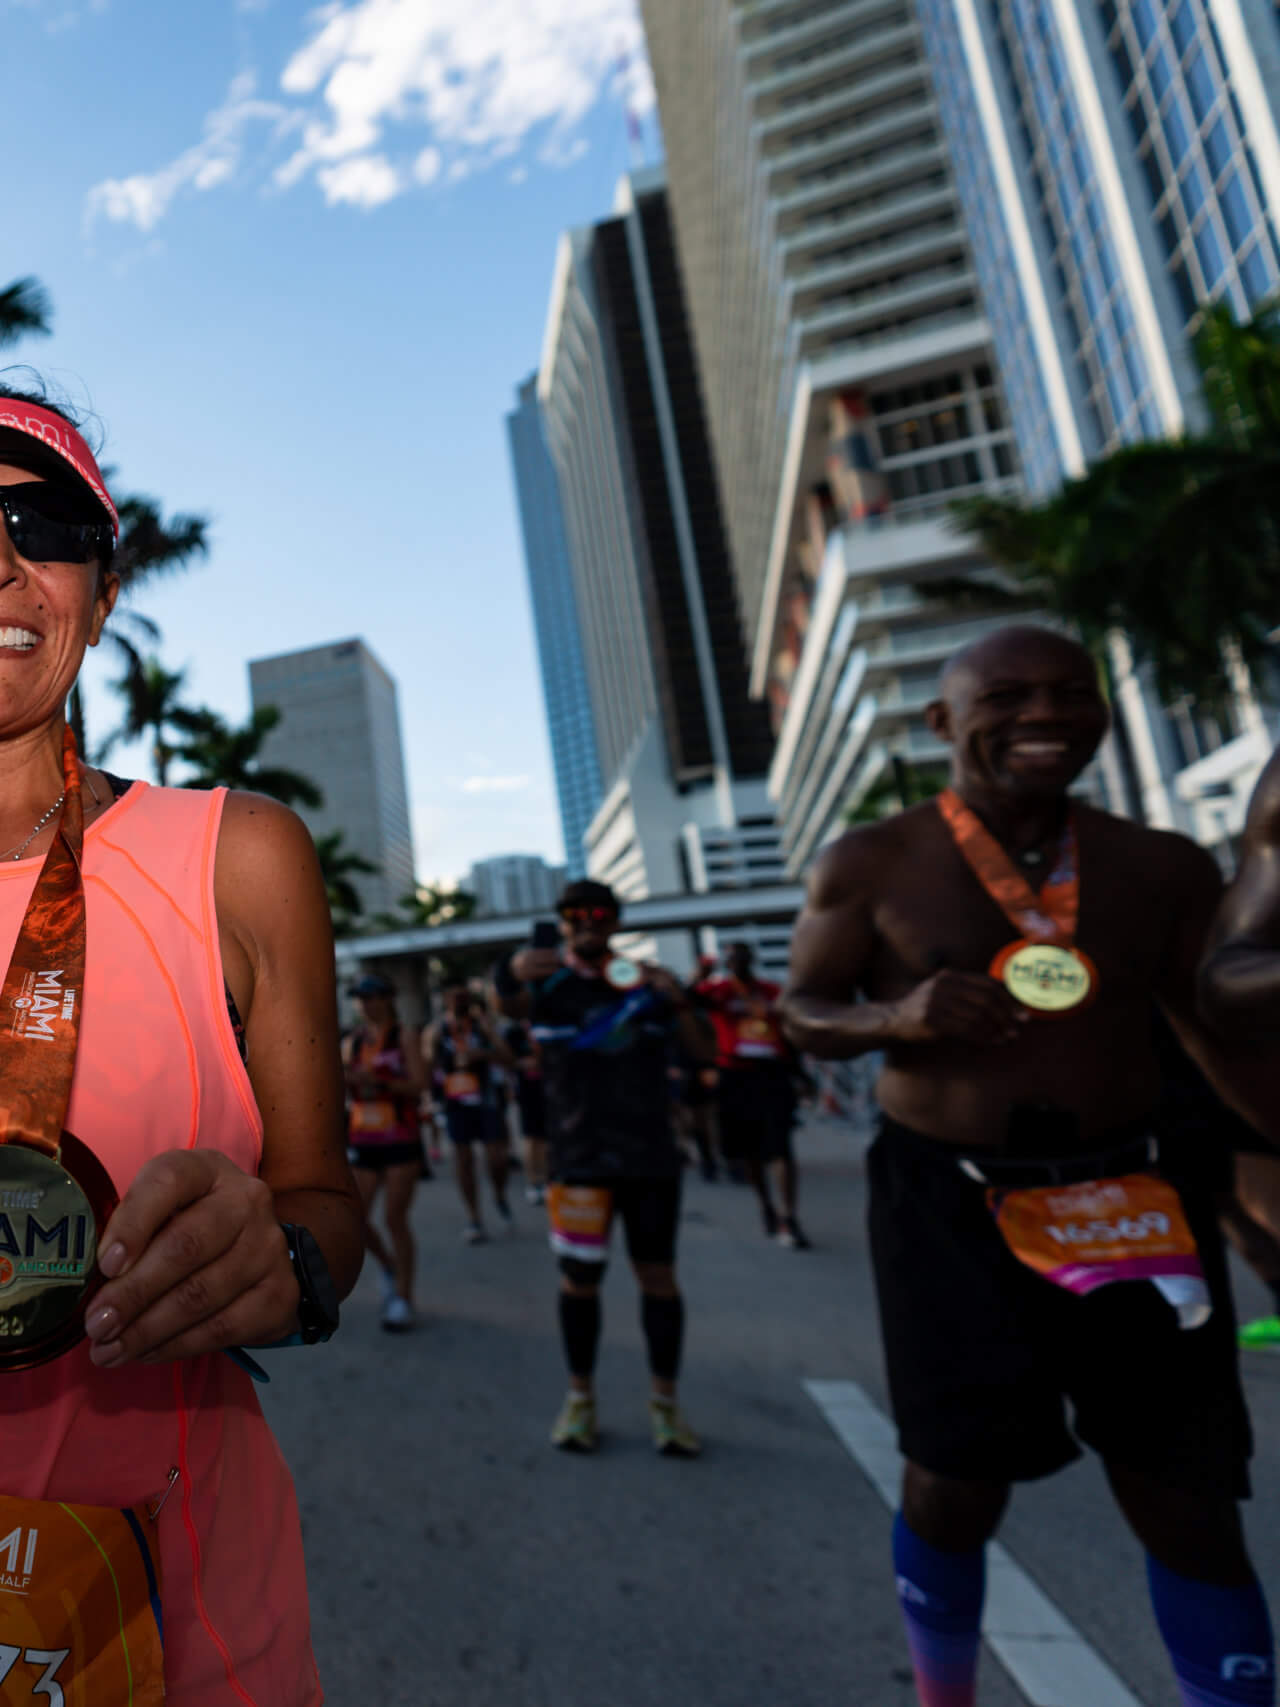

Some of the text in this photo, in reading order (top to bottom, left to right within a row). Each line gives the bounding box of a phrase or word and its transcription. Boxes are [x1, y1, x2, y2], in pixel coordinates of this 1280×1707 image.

[24, 970, 64, 1041] MIAMI
[17, 1261, 48, 1273] AND
[49, 1262, 85, 1275] HALF
